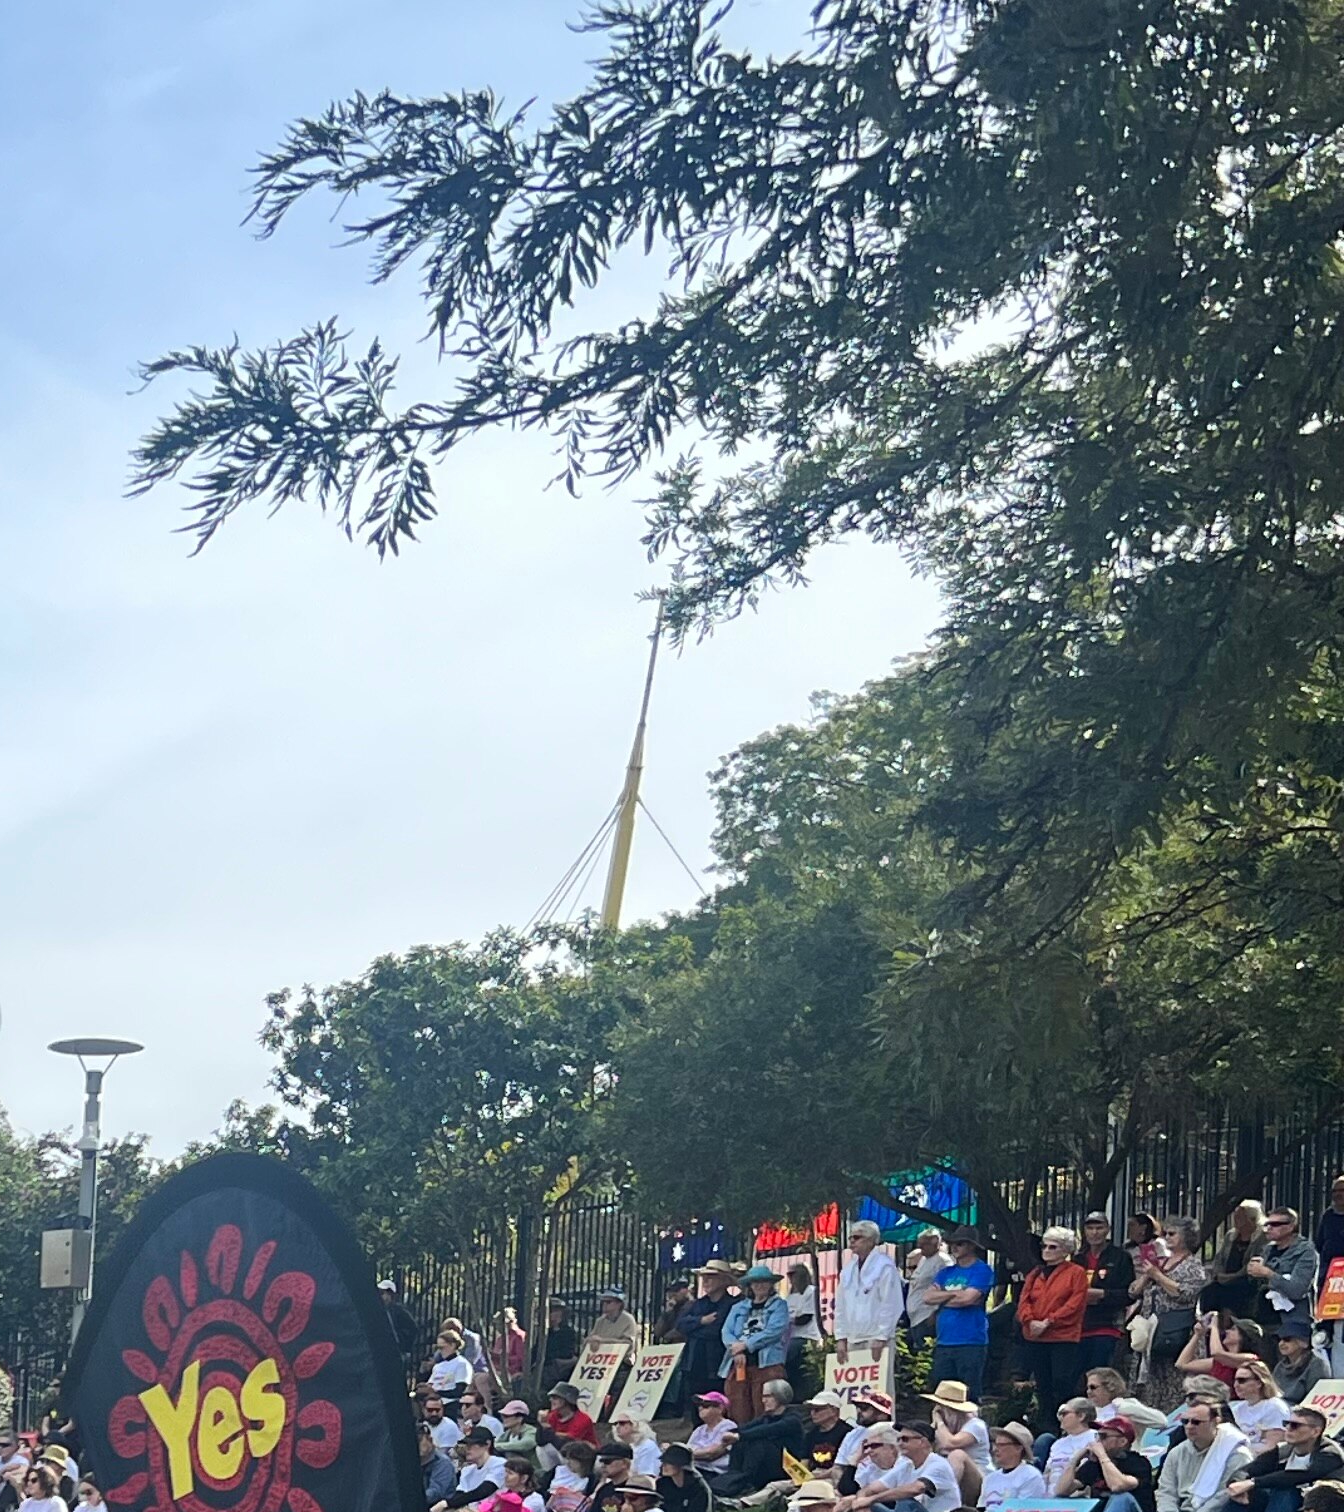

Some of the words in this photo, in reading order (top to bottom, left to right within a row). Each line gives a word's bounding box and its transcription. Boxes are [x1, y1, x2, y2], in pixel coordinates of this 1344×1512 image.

[585, 1353, 619, 1365] VOTE
[641, 1355, 674, 1367] VOTE
[833, 1366, 880, 1384] VOTE
[1312, 1395, 1344, 1410] VOT
[138, 1359, 287, 1500] Yes
